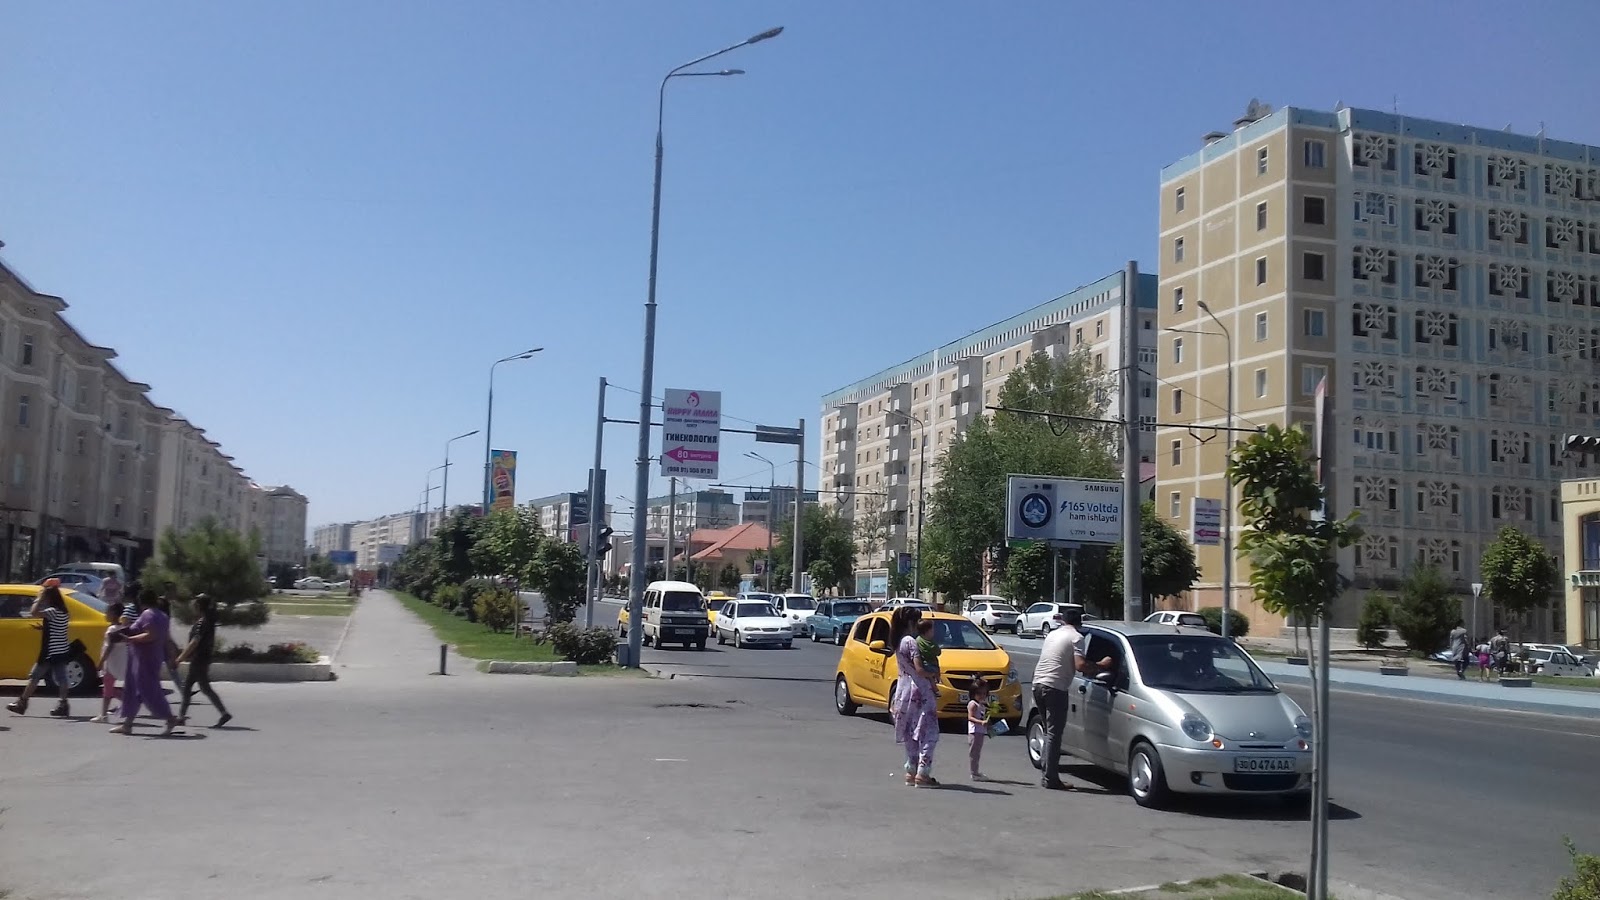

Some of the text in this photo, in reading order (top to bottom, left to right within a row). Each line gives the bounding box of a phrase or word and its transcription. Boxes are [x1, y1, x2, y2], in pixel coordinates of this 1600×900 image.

[666, 433, 718, 443] ГИНЕКОЛОГИЯ
[677, 450, 689, 459] 80
[1084, 484, 1119, 493] SAMSUNG
[1068, 501, 1119, 513] 165 Voltda
[1069, 512, 1118, 524] ham ishlaydi
